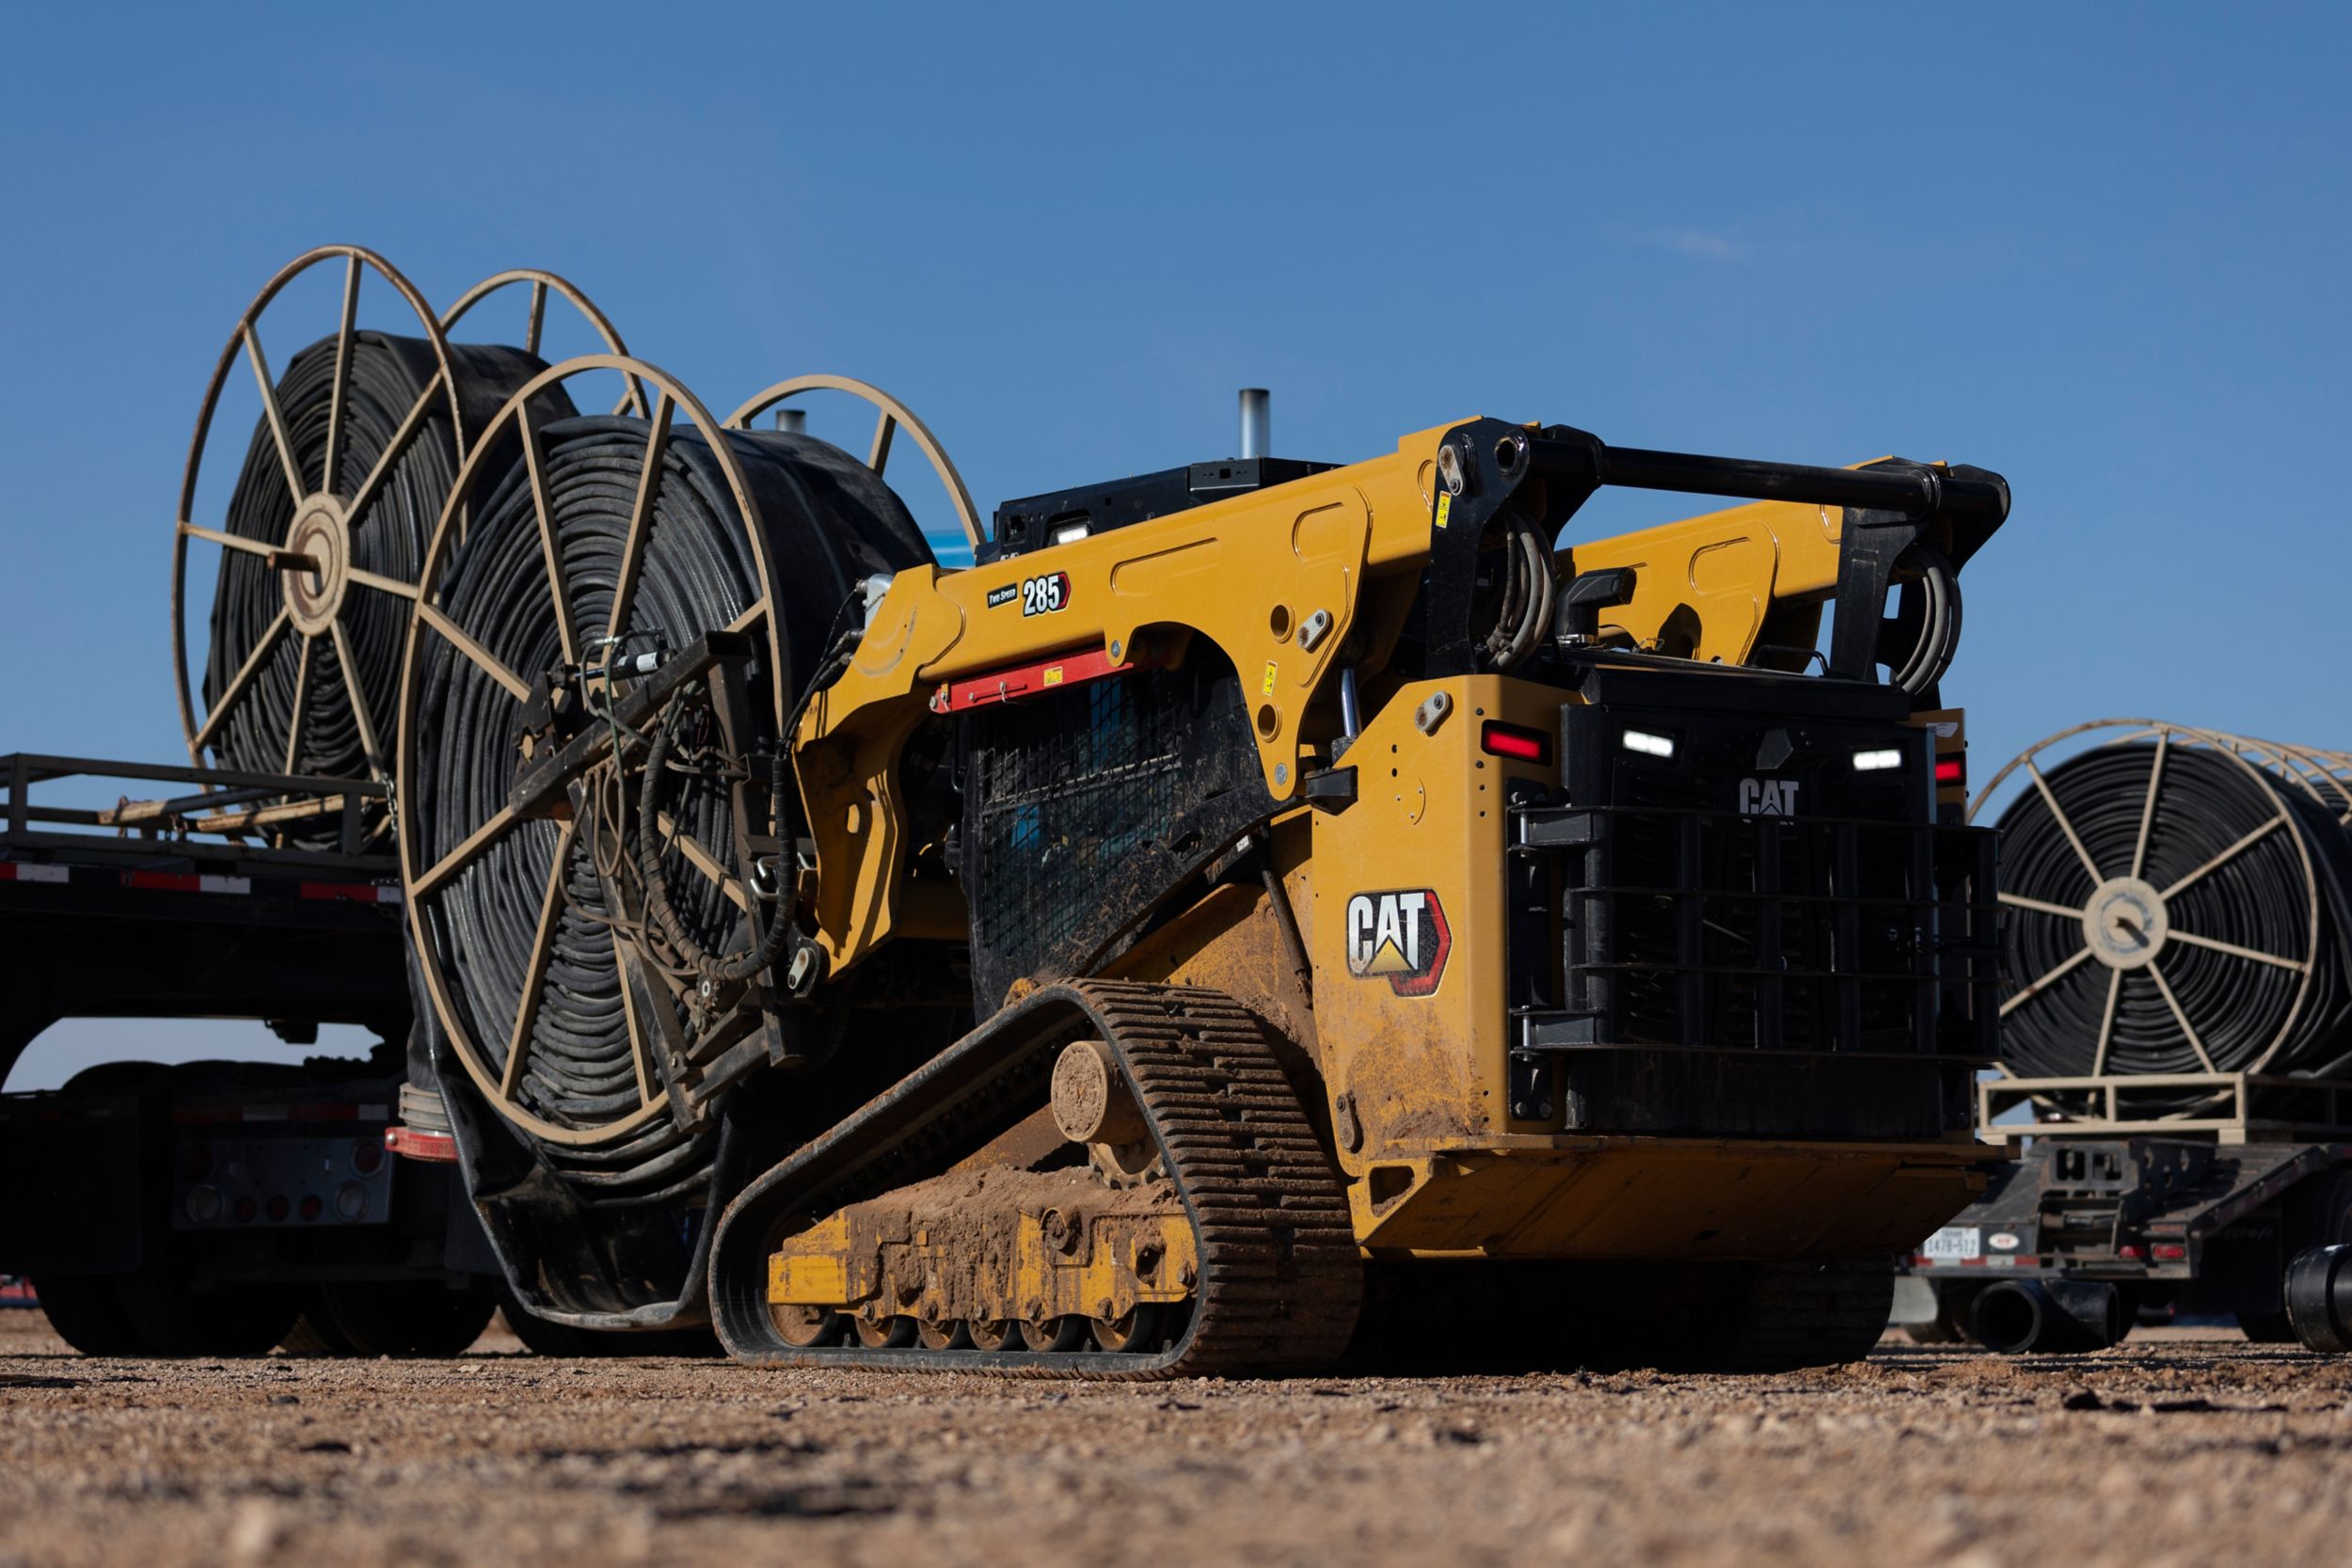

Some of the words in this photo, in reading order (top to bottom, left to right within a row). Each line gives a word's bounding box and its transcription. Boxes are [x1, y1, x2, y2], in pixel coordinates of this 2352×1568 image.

[1023, 574, 1060, 615] 285
[1740, 777, 1800, 826] CAT
[1347, 892, 1425, 974] CAT
